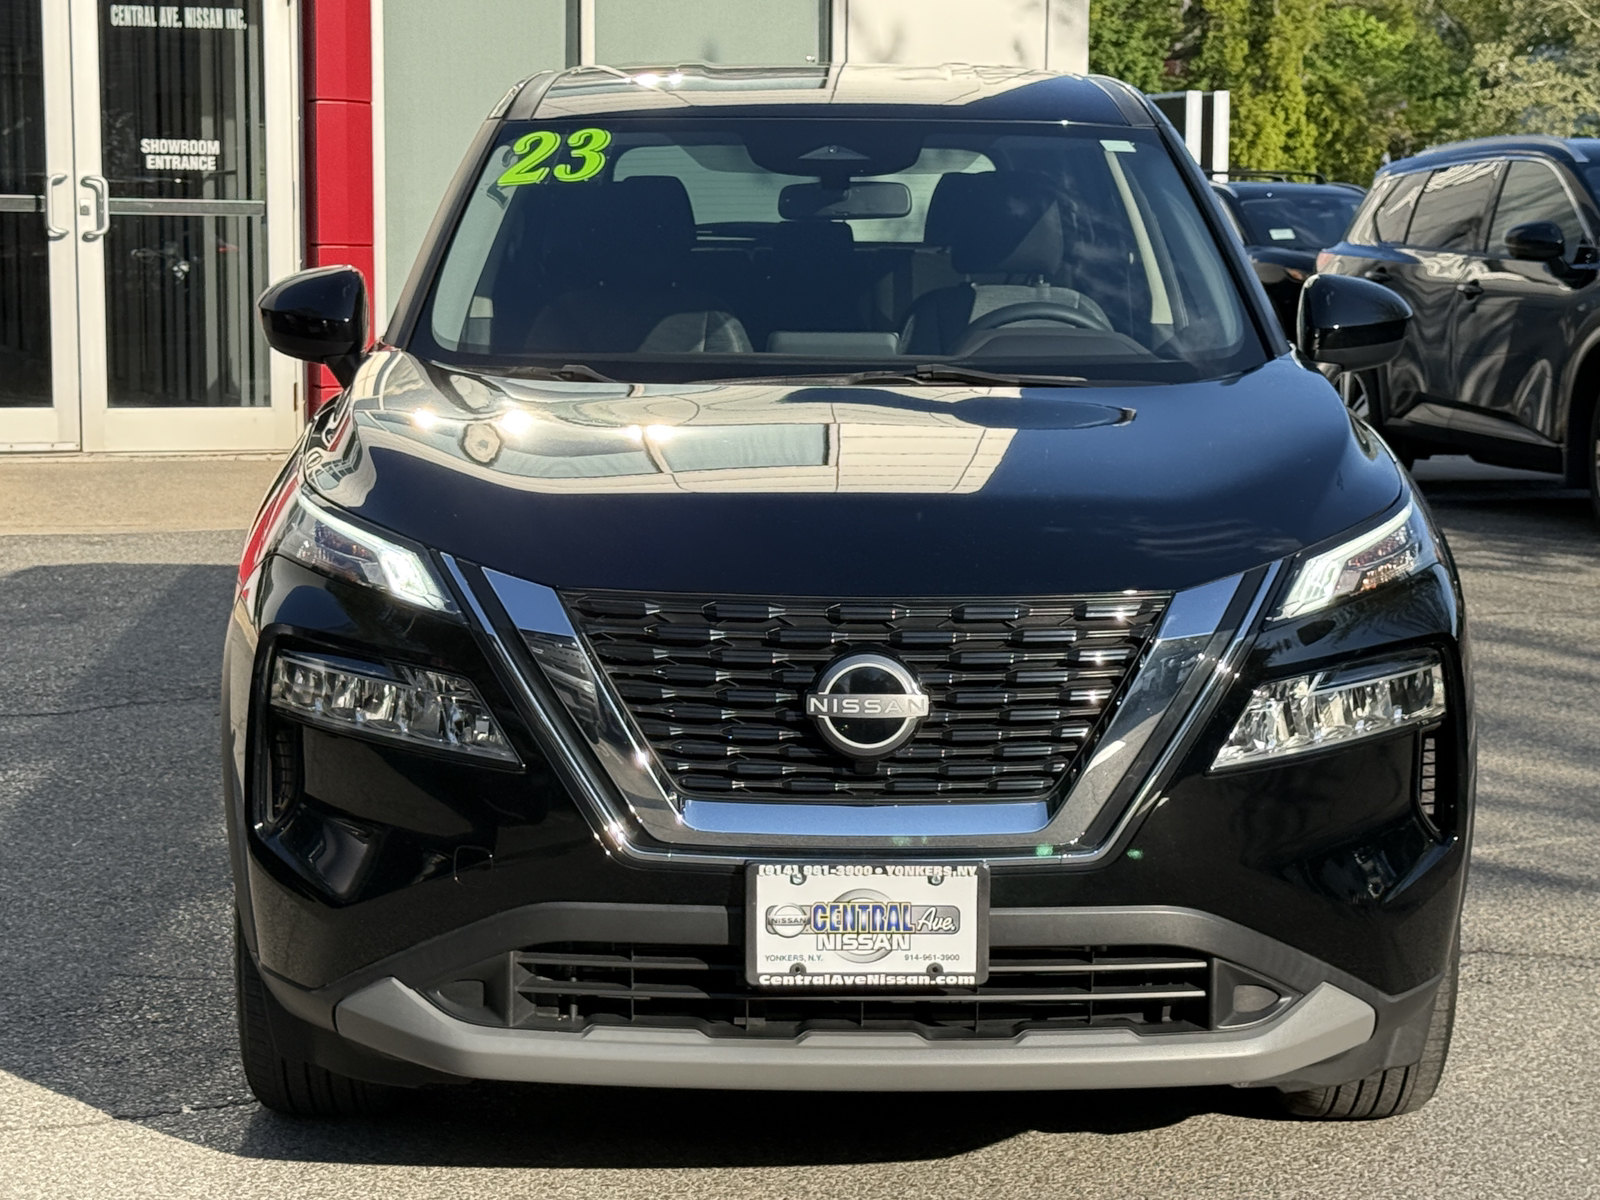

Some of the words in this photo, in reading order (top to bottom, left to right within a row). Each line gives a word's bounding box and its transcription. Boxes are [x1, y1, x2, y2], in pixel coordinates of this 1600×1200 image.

[110, 5, 157, 27] CENTRAL
[159, 7, 182, 28] AVE.
[184, 7, 223, 29] NISSAN
[225, 8, 247, 30] INC.
[140, 139, 220, 155] SHOWROOM
[146, 155, 216, 170] ENTRANCE
[497, 128, 611, 186] 23
[809, 697, 925, 714] NISSAN
[810, 901, 915, 933] CENTRAL
[917, 907, 956, 931] Ave.
[817, 933, 911, 951] NISSAN
[758, 974, 976, 985] CentralAveNissan.com
